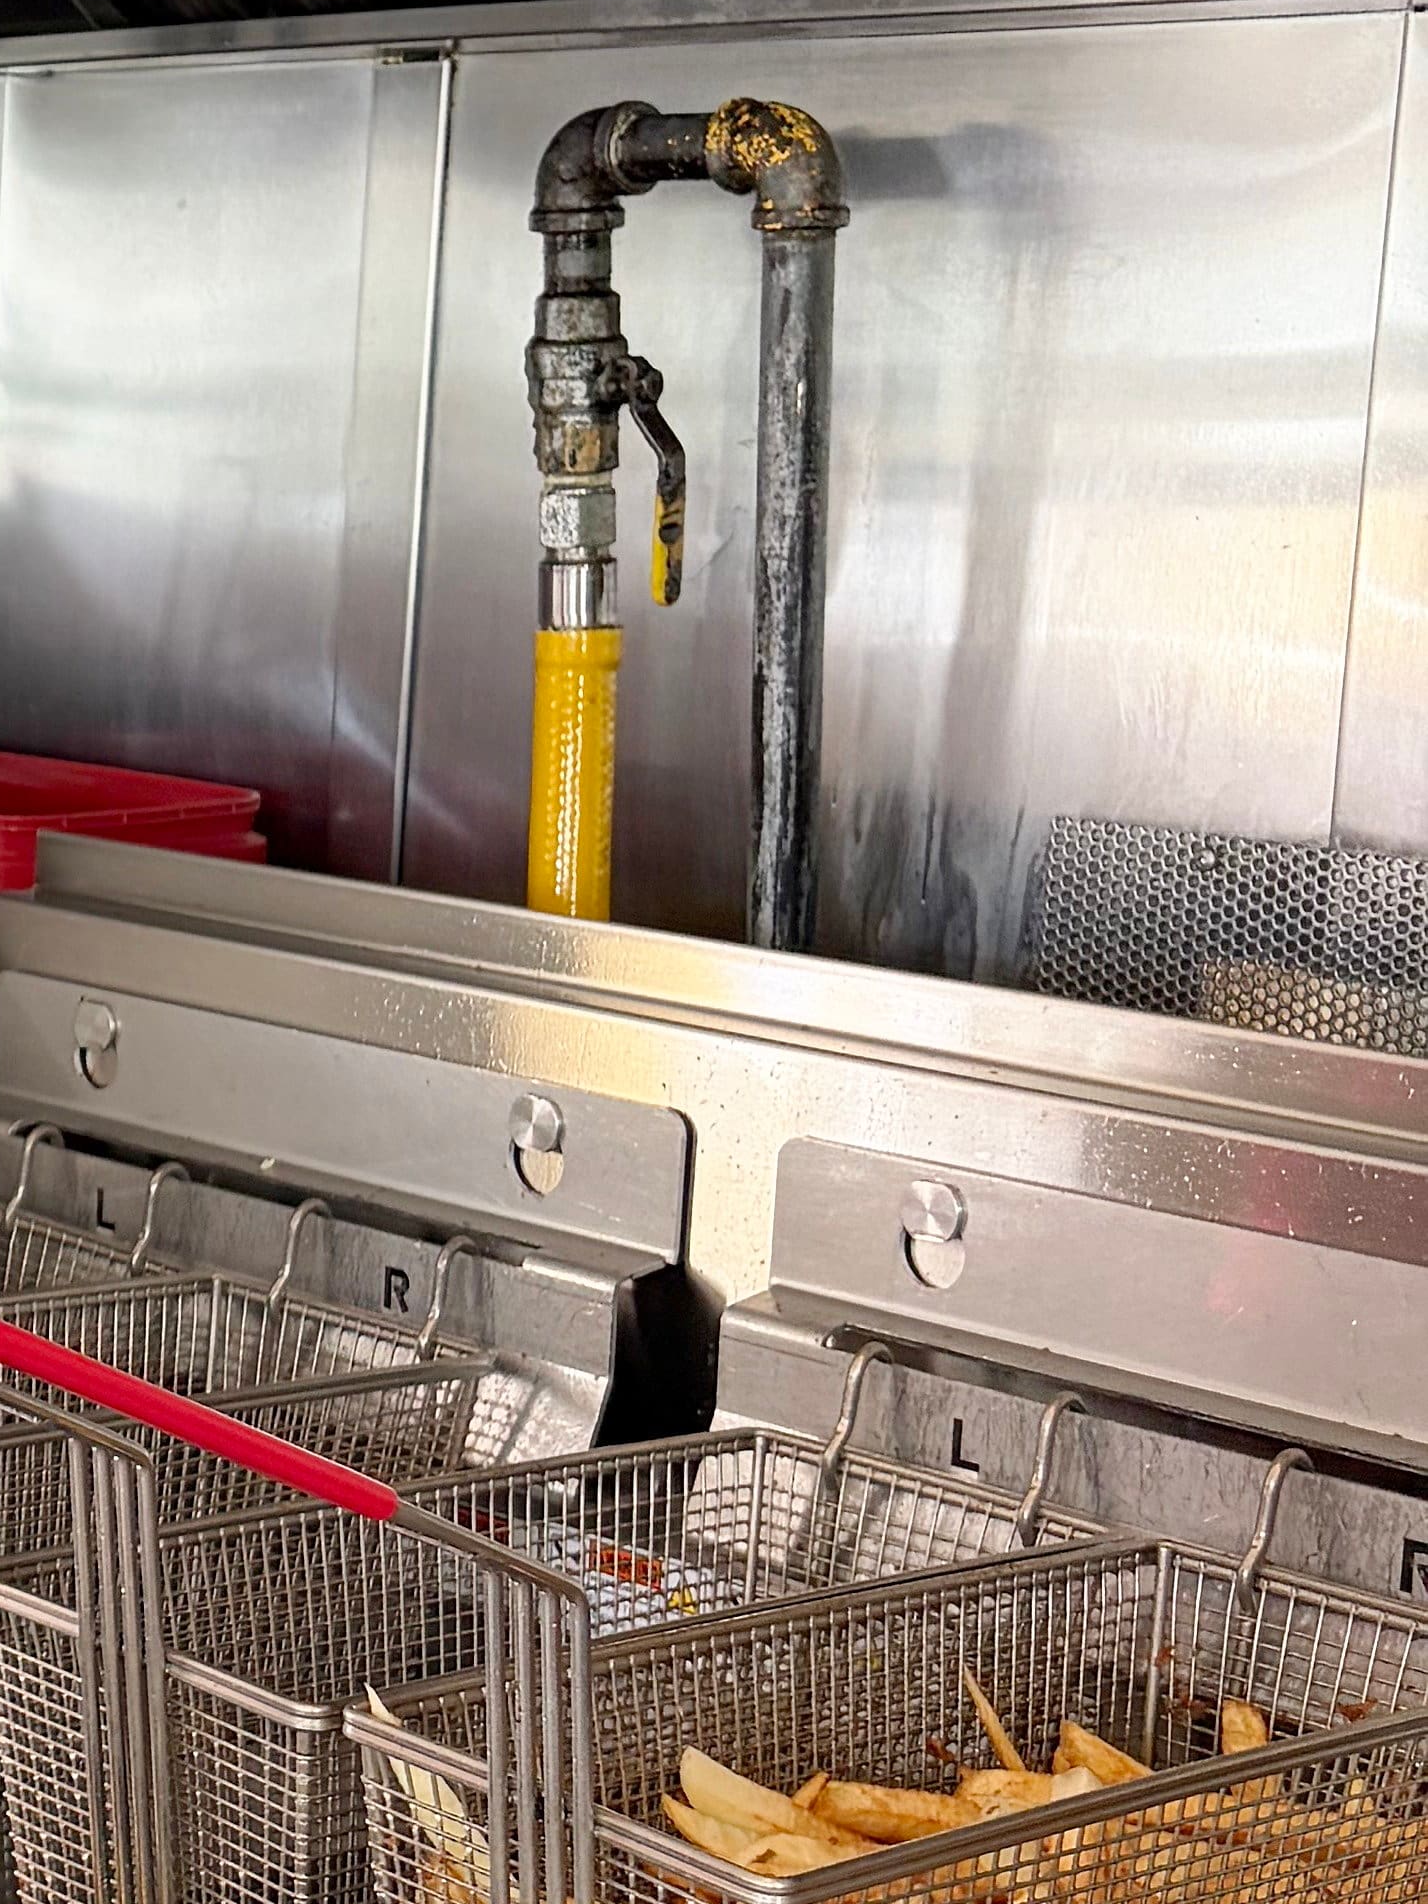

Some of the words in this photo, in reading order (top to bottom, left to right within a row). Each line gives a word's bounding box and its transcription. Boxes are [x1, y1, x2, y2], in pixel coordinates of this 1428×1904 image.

[96, 1188, 116, 1230] L
[384, 1265, 410, 1313] R
[952, 1418, 980, 1472] L
